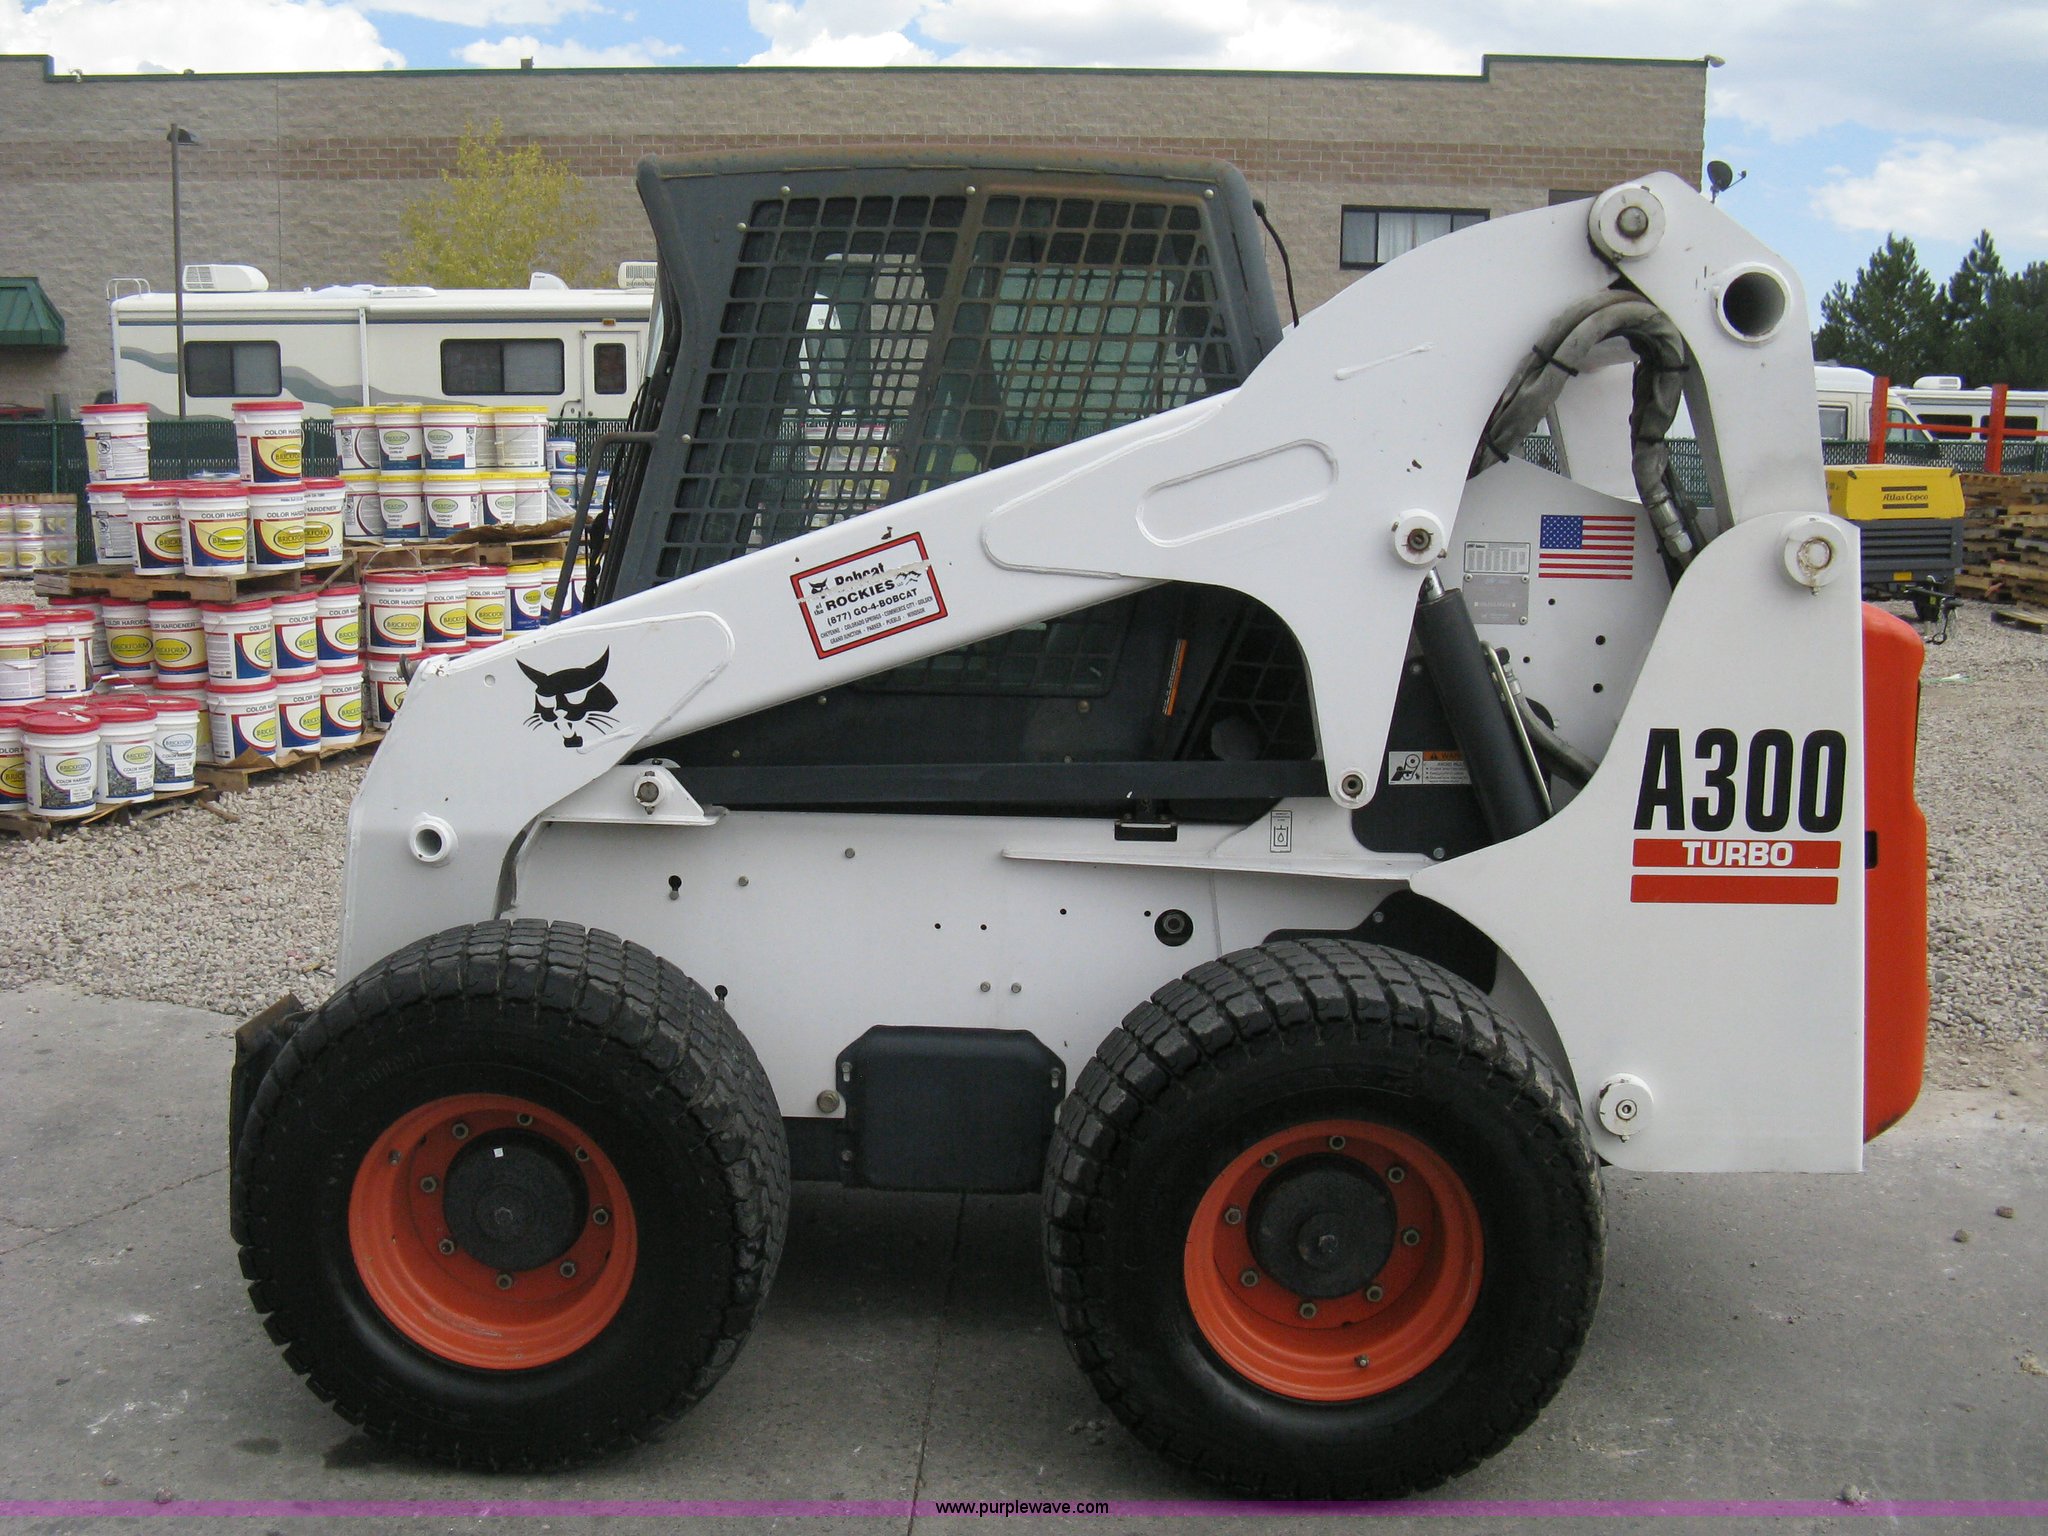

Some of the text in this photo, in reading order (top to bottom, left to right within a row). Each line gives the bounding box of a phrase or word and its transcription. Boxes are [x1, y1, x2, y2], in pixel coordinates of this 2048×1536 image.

[1882, 493, 1929, 502] Atlas Copco
[825, 579, 895, 611] ROCKIES
[827, 588, 918, 627] (877) GO-4-BOBCAT
[329, 608, 350, 616] COLOR
[820, 627, 841, 639] CHEYENNE
[844, 619, 865, 631] COLORADO
[865, 613, 882, 623] SPRINGS
[830, 635, 844, 645] GRAND
[844, 628, 862, 639] JUNCTION
[867, 622, 882, 632] PARKER
[886, 615, 902, 625] PUEBLO
[293, 694, 313, 702] COLOR
[332, 686, 352, 694] COLOR
[246, 704, 267, 713] COLOR
[1633, 728, 1847, 833] A300
[1682, 841, 1793, 866] TURBO
